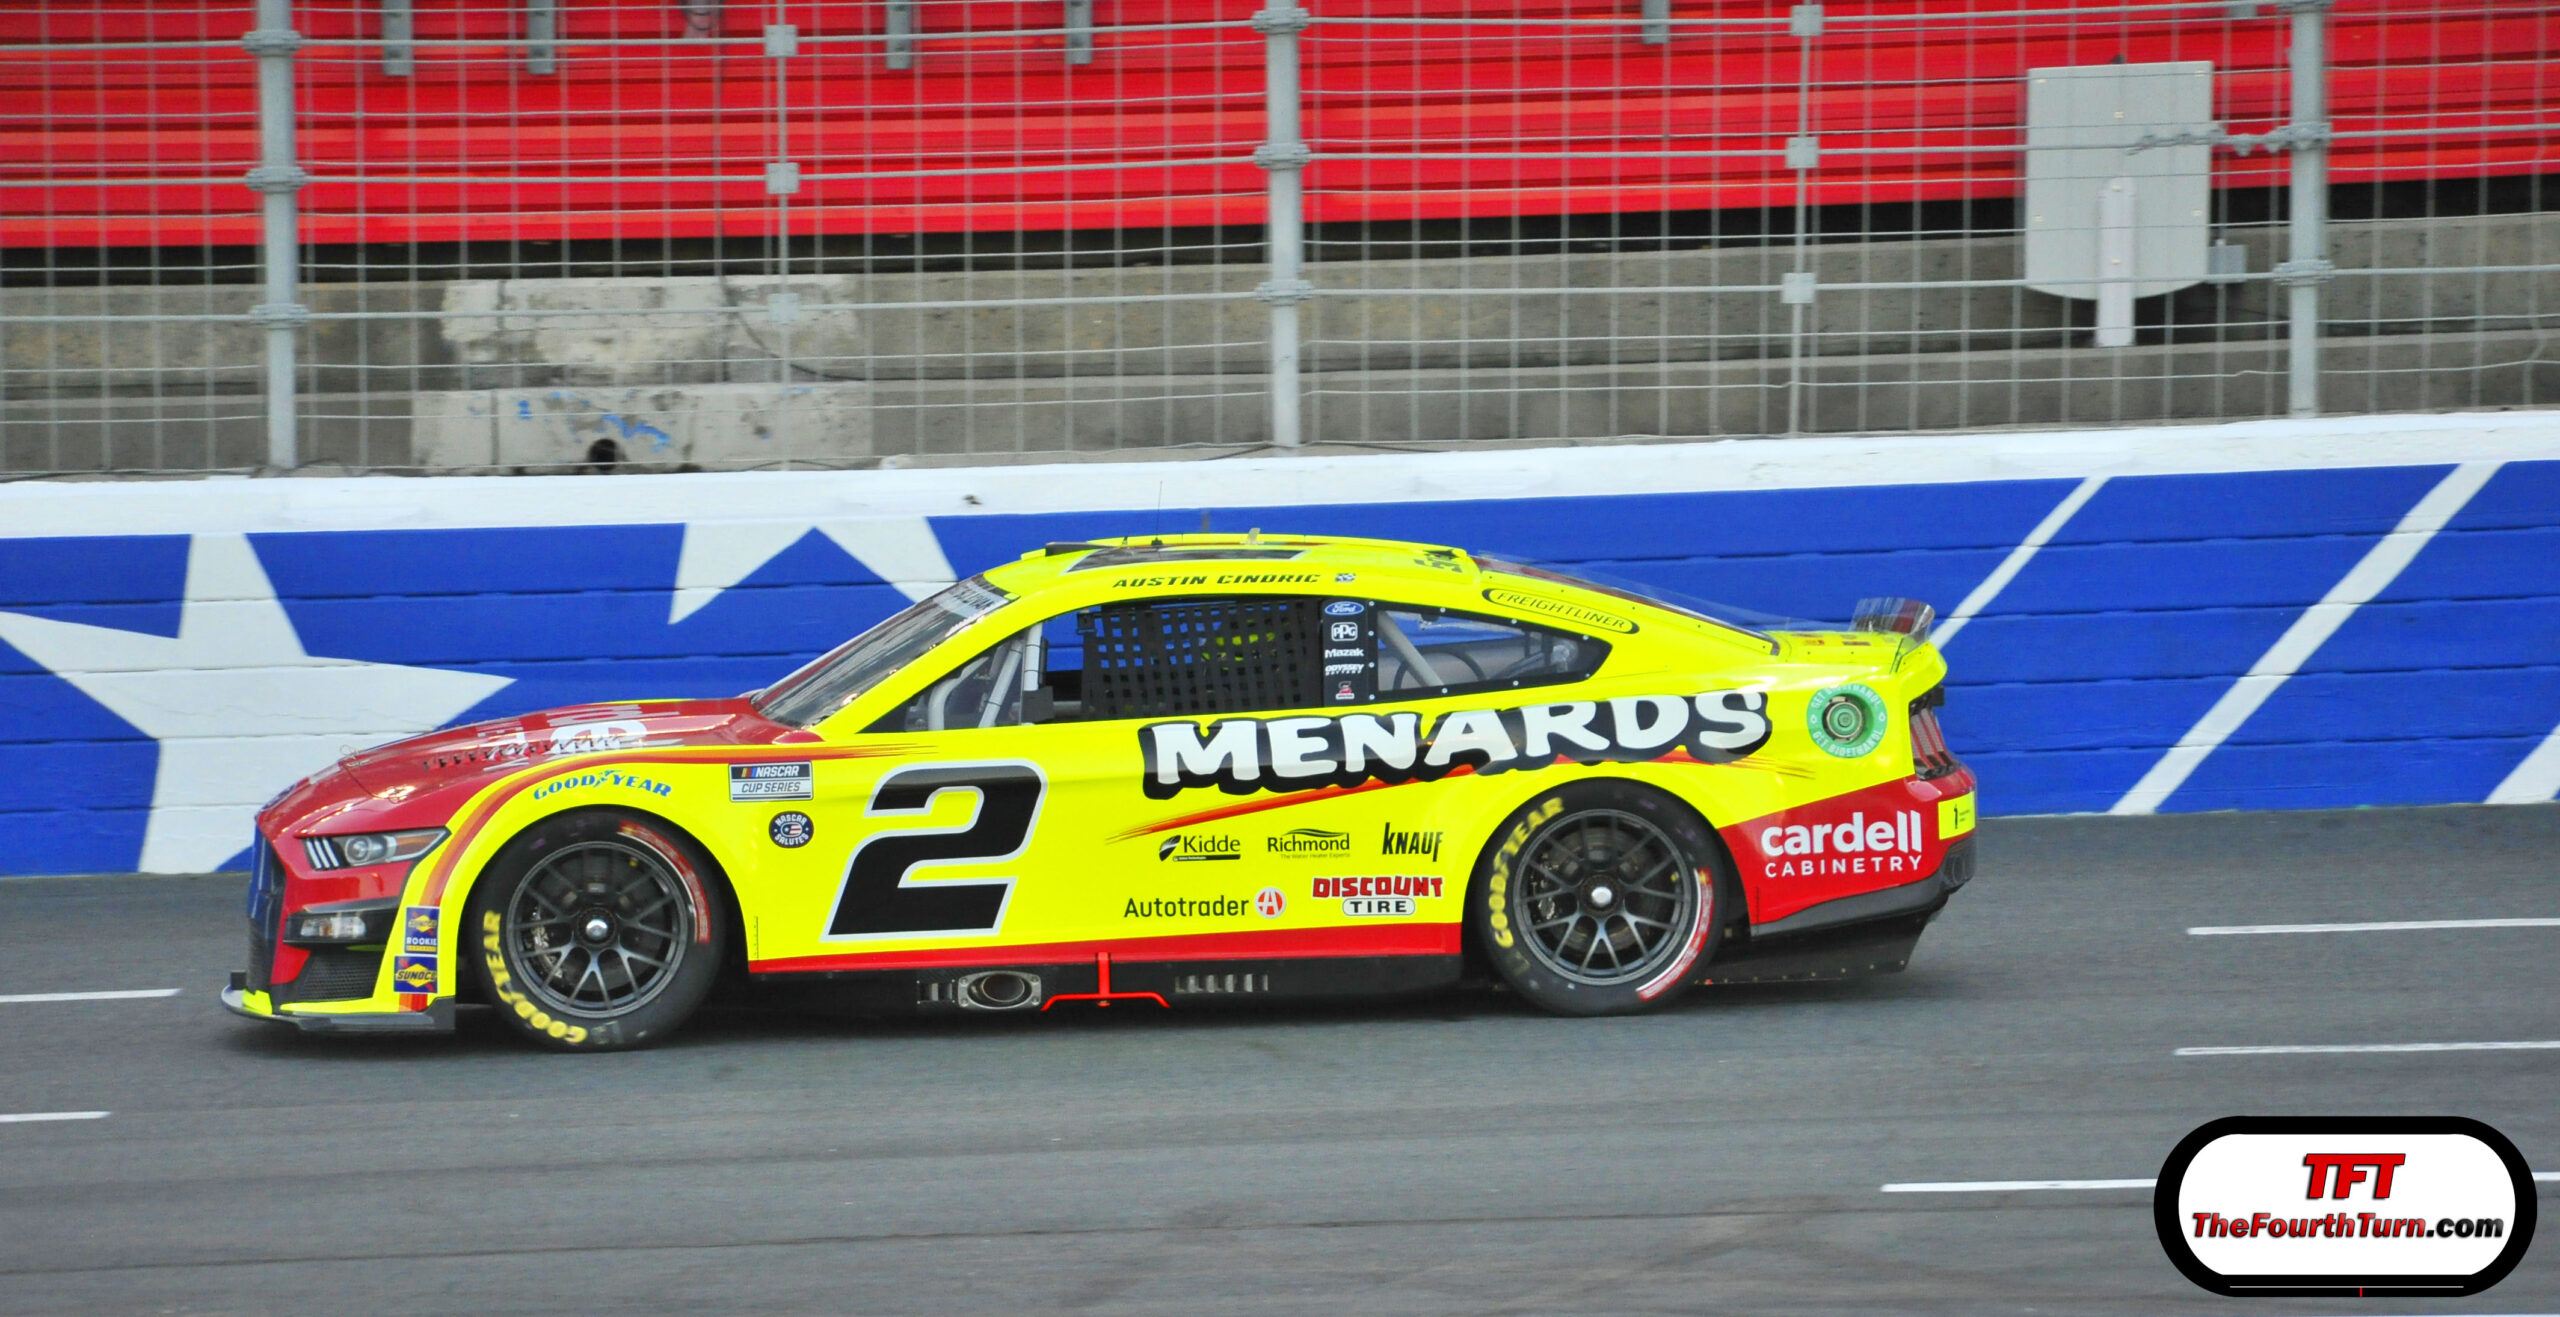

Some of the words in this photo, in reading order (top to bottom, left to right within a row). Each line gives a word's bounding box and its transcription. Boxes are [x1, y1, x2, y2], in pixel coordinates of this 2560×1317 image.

[1112, 576, 1208, 588] AUSTIN
[1217, 574, 1321, 584] CINDRIC
[1496, 592, 1626, 629] FREIGHTLINER
[1333, 624, 1356, 639] PPG
[1325, 648, 1364, 658] Mazak
[1147, 690, 1769, 792] MENARDS
[755, 766, 799, 777] NASCAR
[533, 772, 672, 799] GOODYEAR
[742, 783, 763, 793] CUP
[764, 782, 801, 792] SERIES
[775, 814, 808, 826] NASCAR
[774, 833, 809, 845] SALUTES
[1267, 833, 1350, 852] Richmond
[1761, 810, 1922, 857] cardell
[820, 758, 1048, 942] 2
[1184, 835, 1240, 853] Kidde
[1765, 856, 1922, 878] CABINETRY
[1312, 876, 1443, 897] DISCOUNT
[1124, 895, 1249, 918] Autotrader
[1351, 901, 1407, 913] TIRE
